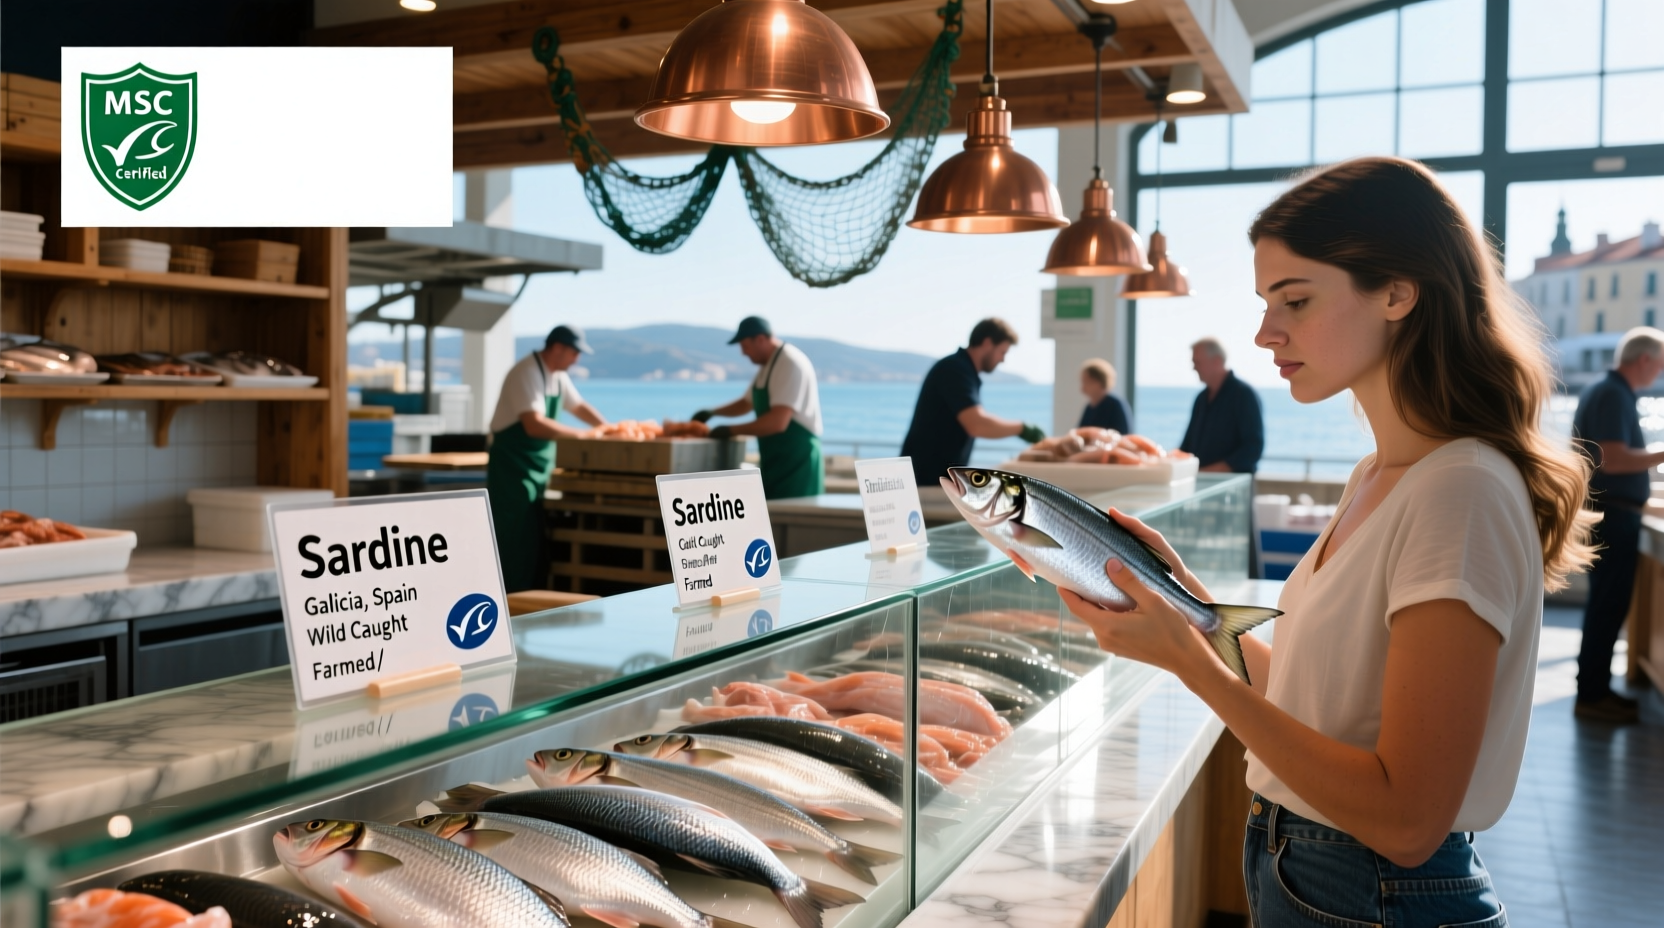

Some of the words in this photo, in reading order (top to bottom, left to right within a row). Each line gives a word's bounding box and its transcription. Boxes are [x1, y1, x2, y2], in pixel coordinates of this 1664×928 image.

[672, 492, 745, 527] Sardine
[297, 525, 449, 579] Sardine
[304, 591, 369, 616] Galicia,
[372, 583, 418, 611] Spain
[306, 622, 347, 647] Wild
[350, 614, 409, 641] Caught
